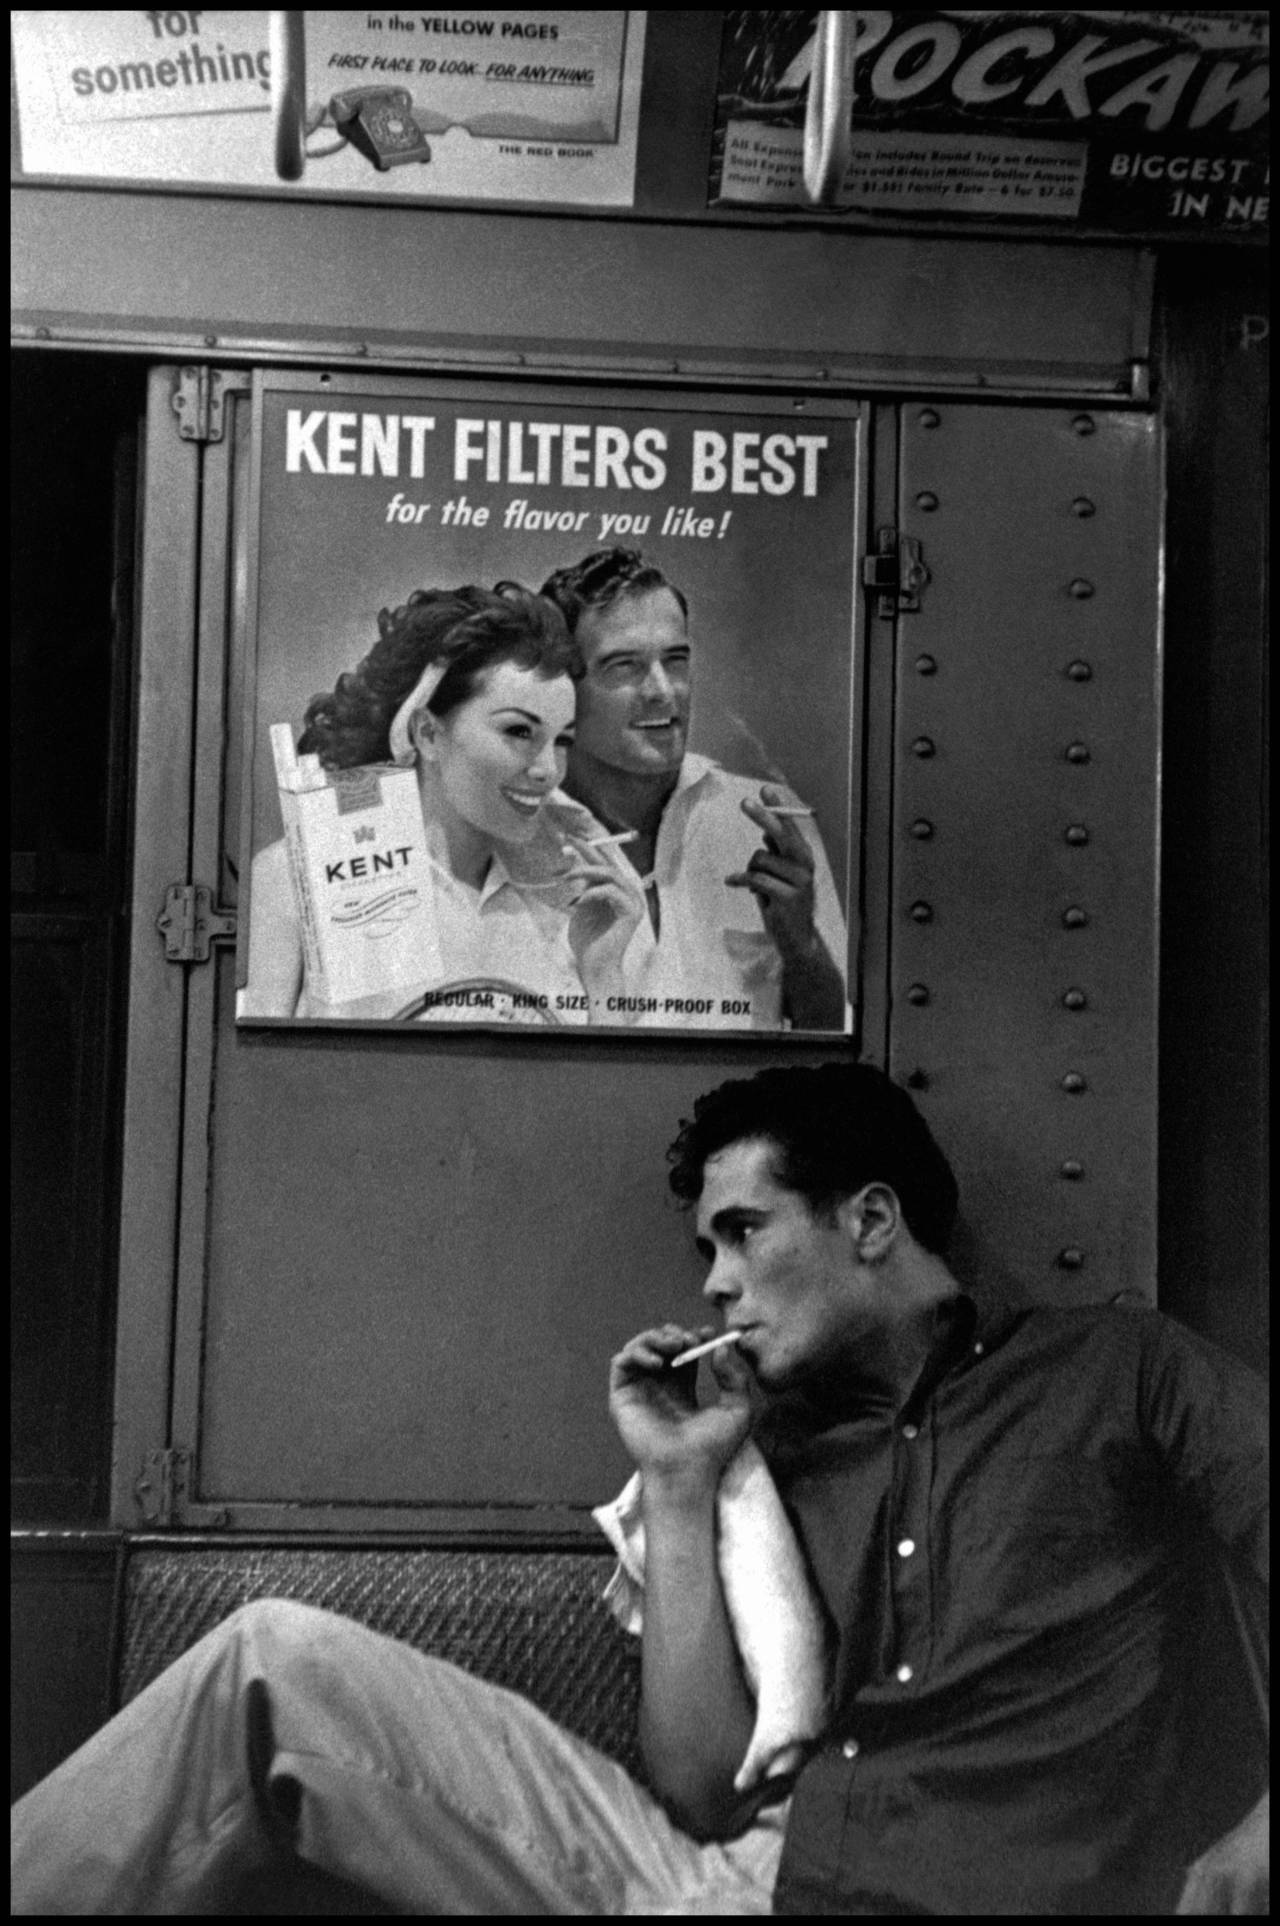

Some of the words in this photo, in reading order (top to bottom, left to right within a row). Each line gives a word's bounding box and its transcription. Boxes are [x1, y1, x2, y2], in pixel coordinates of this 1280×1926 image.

[147, 11, 202, 38] for
[367, 15, 382, 30] in
[389, 15, 415, 31] the
[421, 17, 494, 37] YELLOW
[502, 22, 559, 40] PAGES
[328, 54, 368, 69] FIRST
[371, 57, 414, 73] PLACE
[419, 59, 437, 73] TO
[485, 64, 517, 79] FOR
[518, 65, 595, 83] ANYTHING
[499, 145, 522, 156] THE
[527, 147, 553, 158] RED
[976, 152, 999, 165] Trip
[1110, 152, 1250, 184] BIGGEST
[1168, 188, 1210, 218] IN
[286, 409, 435, 479] KENT
[454, 418, 667, 490] FILTERS
[692, 430, 828, 497] BEST
[385, 494, 429, 525] for
[441, 496, 489, 528] the
[503, 500, 588, 532] flavor
[598, 511, 650, 540] you
[661, 507, 731, 538] like!
[325, 846, 414, 883] KENT
[424, 991, 495, 1011] REGULAR
[512, 993, 548, 1010] KING
[556, 995, 590, 1011] SIZE
[606, 996, 714, 1015] CRUSH-PROOF
[721, 999, 751, 1016] BOX
